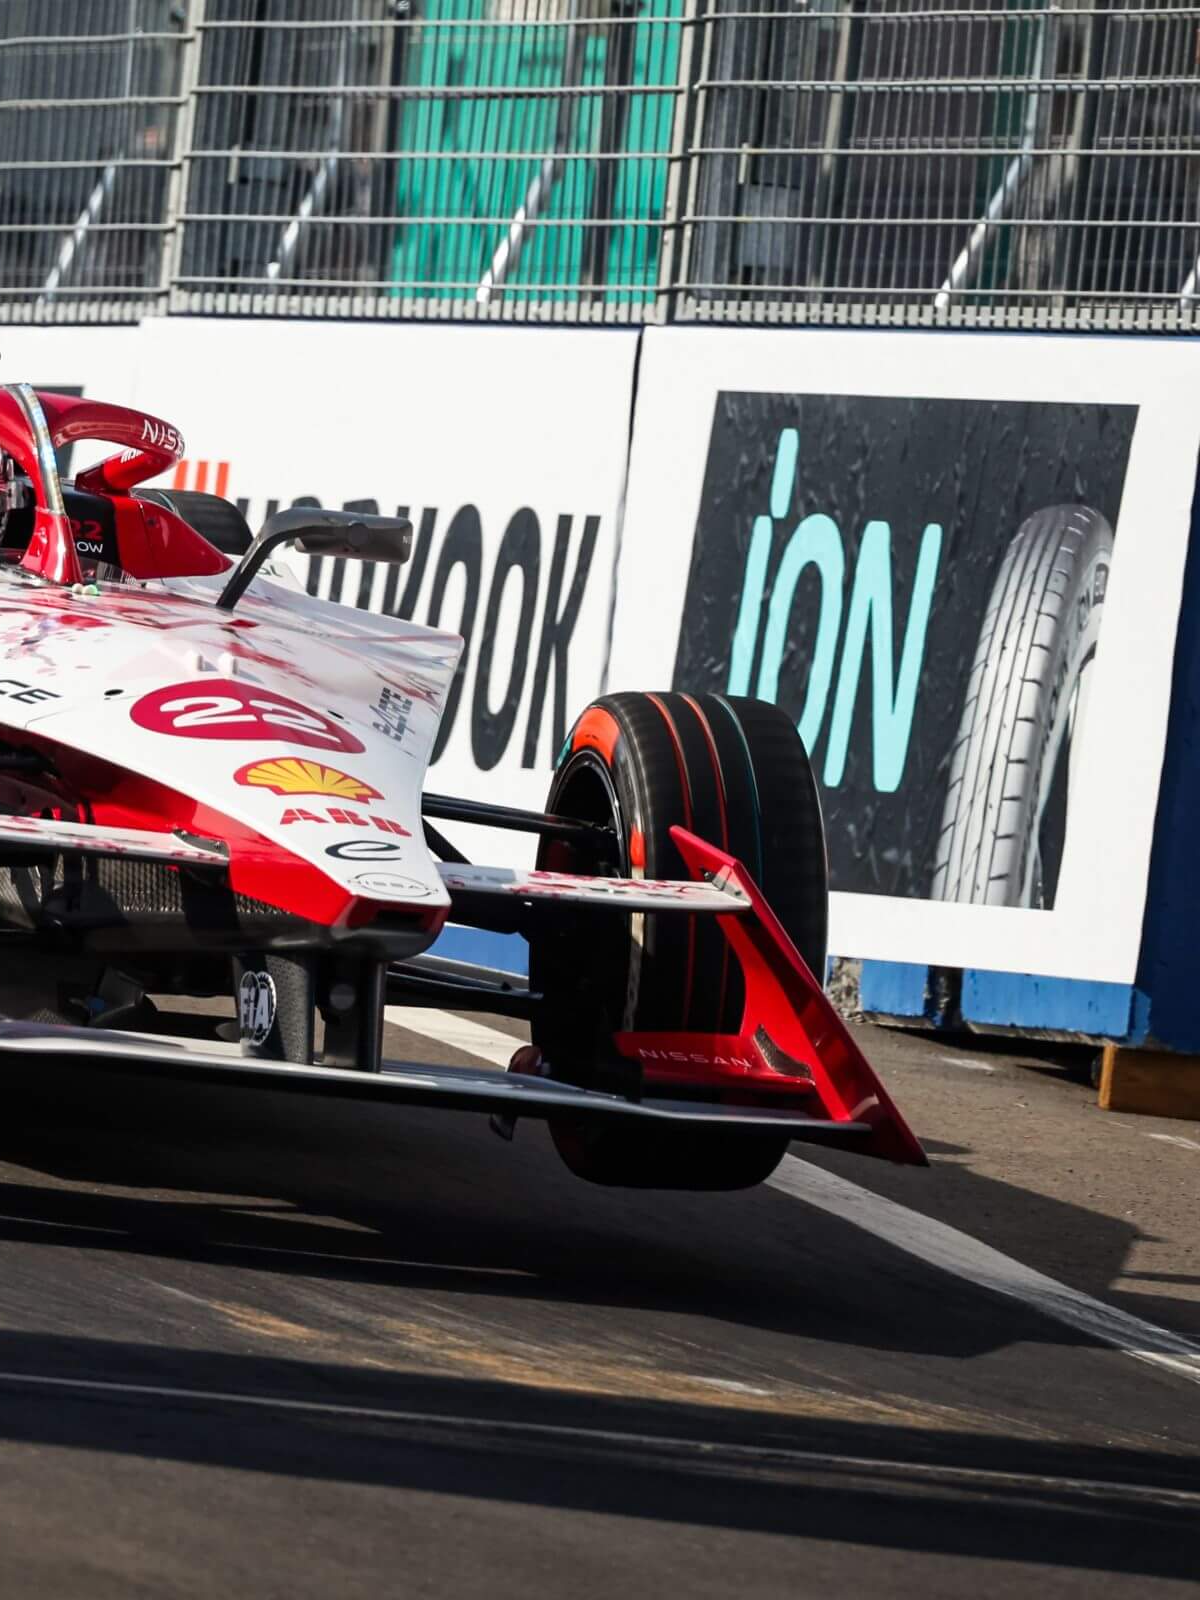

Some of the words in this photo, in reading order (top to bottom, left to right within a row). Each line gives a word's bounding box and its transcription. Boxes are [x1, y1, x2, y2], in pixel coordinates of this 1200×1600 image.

[76, 541, 103, 553] OW
[160, 696, 343, 745] 22
[280, 808, 412, 837] ABB
[240, 987, 269, 1028] FIA
[638, 1048, 752, 1068] NISSAN
